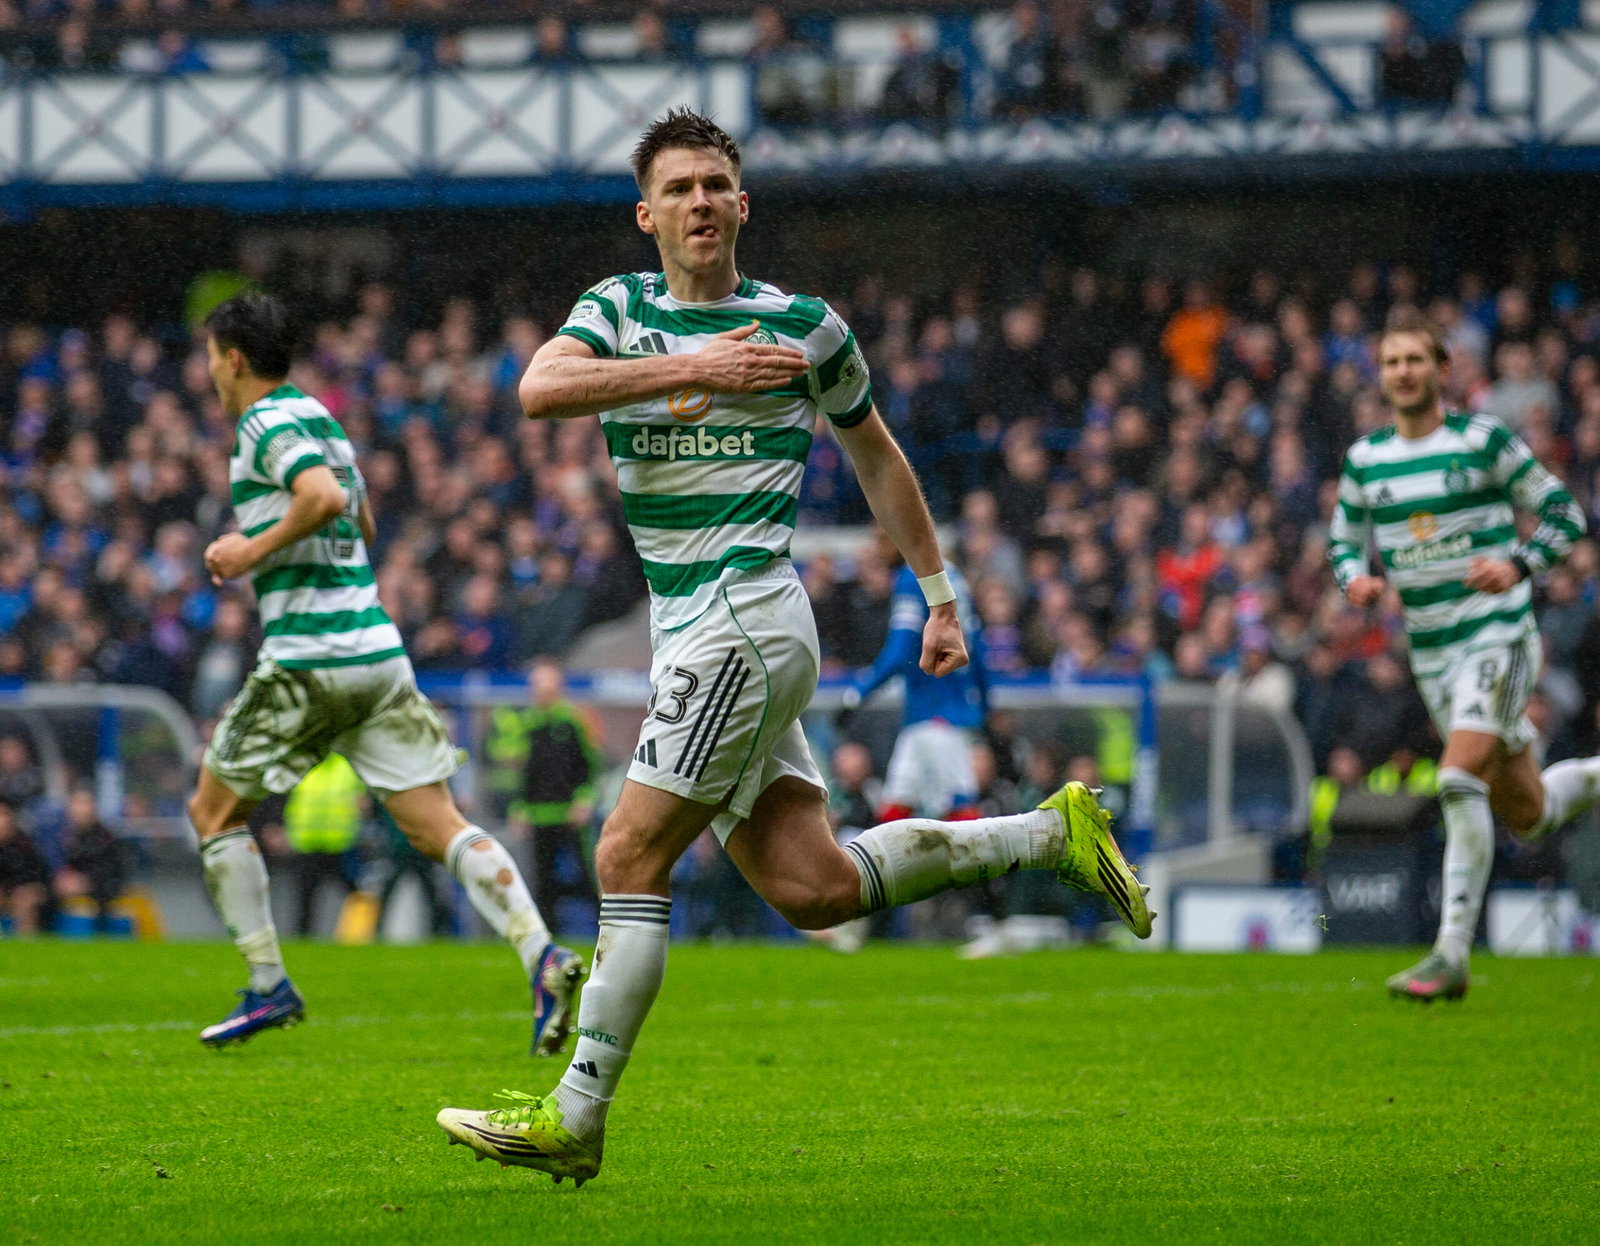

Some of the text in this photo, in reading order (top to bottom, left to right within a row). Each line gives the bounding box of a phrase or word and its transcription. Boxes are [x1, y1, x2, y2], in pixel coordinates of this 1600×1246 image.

[631, 425, 755, 462] dafabet
[648, 665, 699, 725] 3
[579, 1026, 618, 1046] CELTIC
